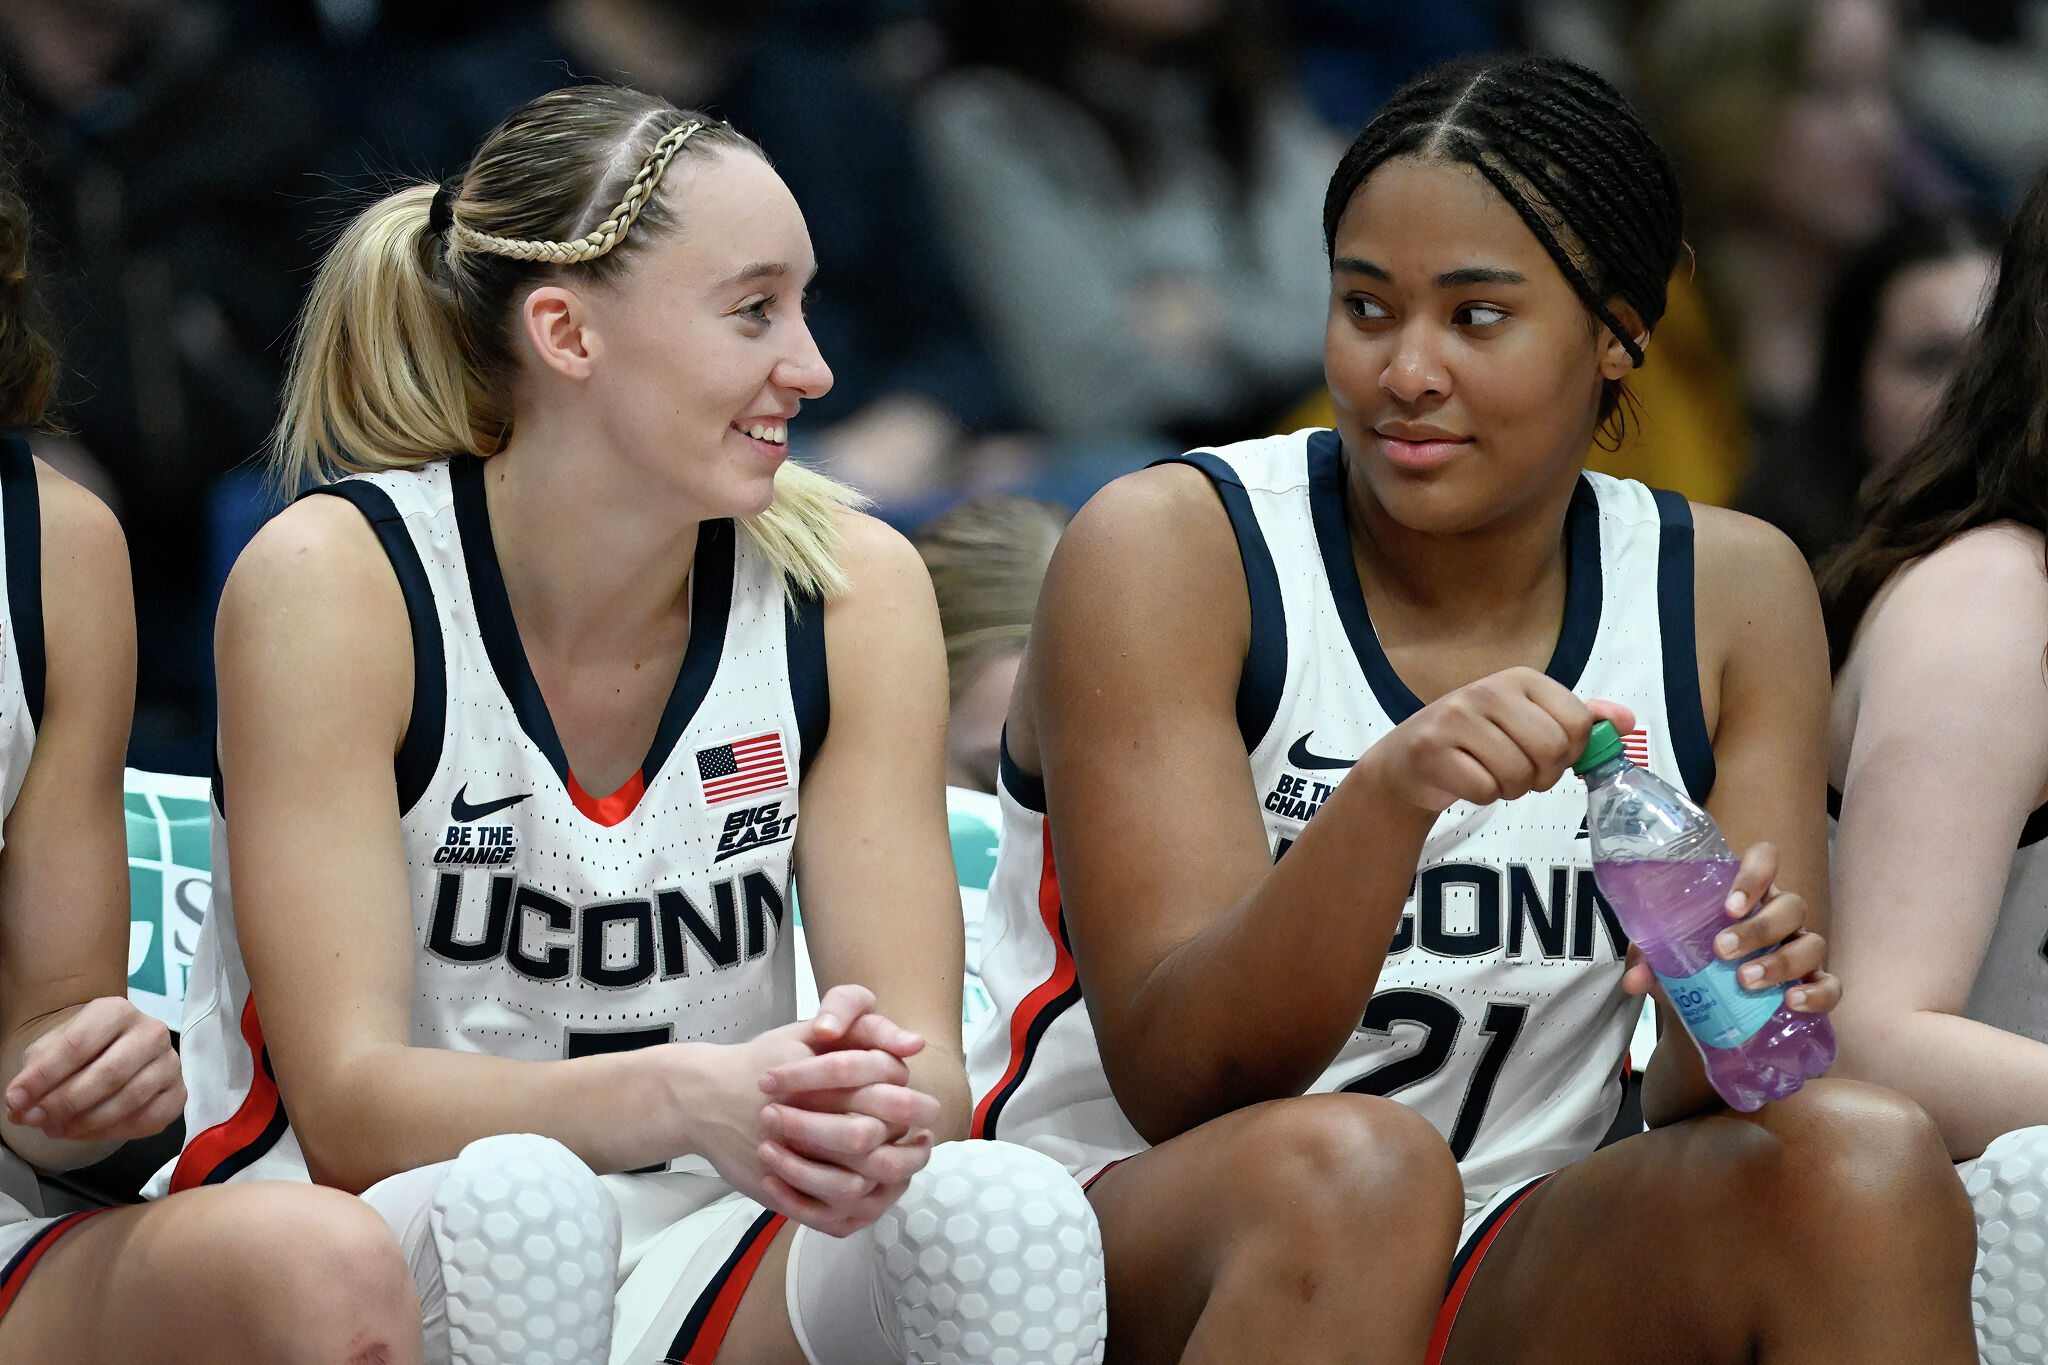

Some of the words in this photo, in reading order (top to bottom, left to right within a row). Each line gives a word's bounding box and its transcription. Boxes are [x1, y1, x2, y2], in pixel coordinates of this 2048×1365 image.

[1276, 773, 1307, 799] BE
[1311, 781, 1337, 804] TH
[723, 800, 783, 832] BIG
[1264, 791, 1322, 822] CHAN
[445, 825, 472, 846] BE
[477, 826, 513, 846] THE
[716, 813, 798, 852] EAST
[433, 846, 517, 865] CHANGE
[1334, 986, 1530, 1164] 21
